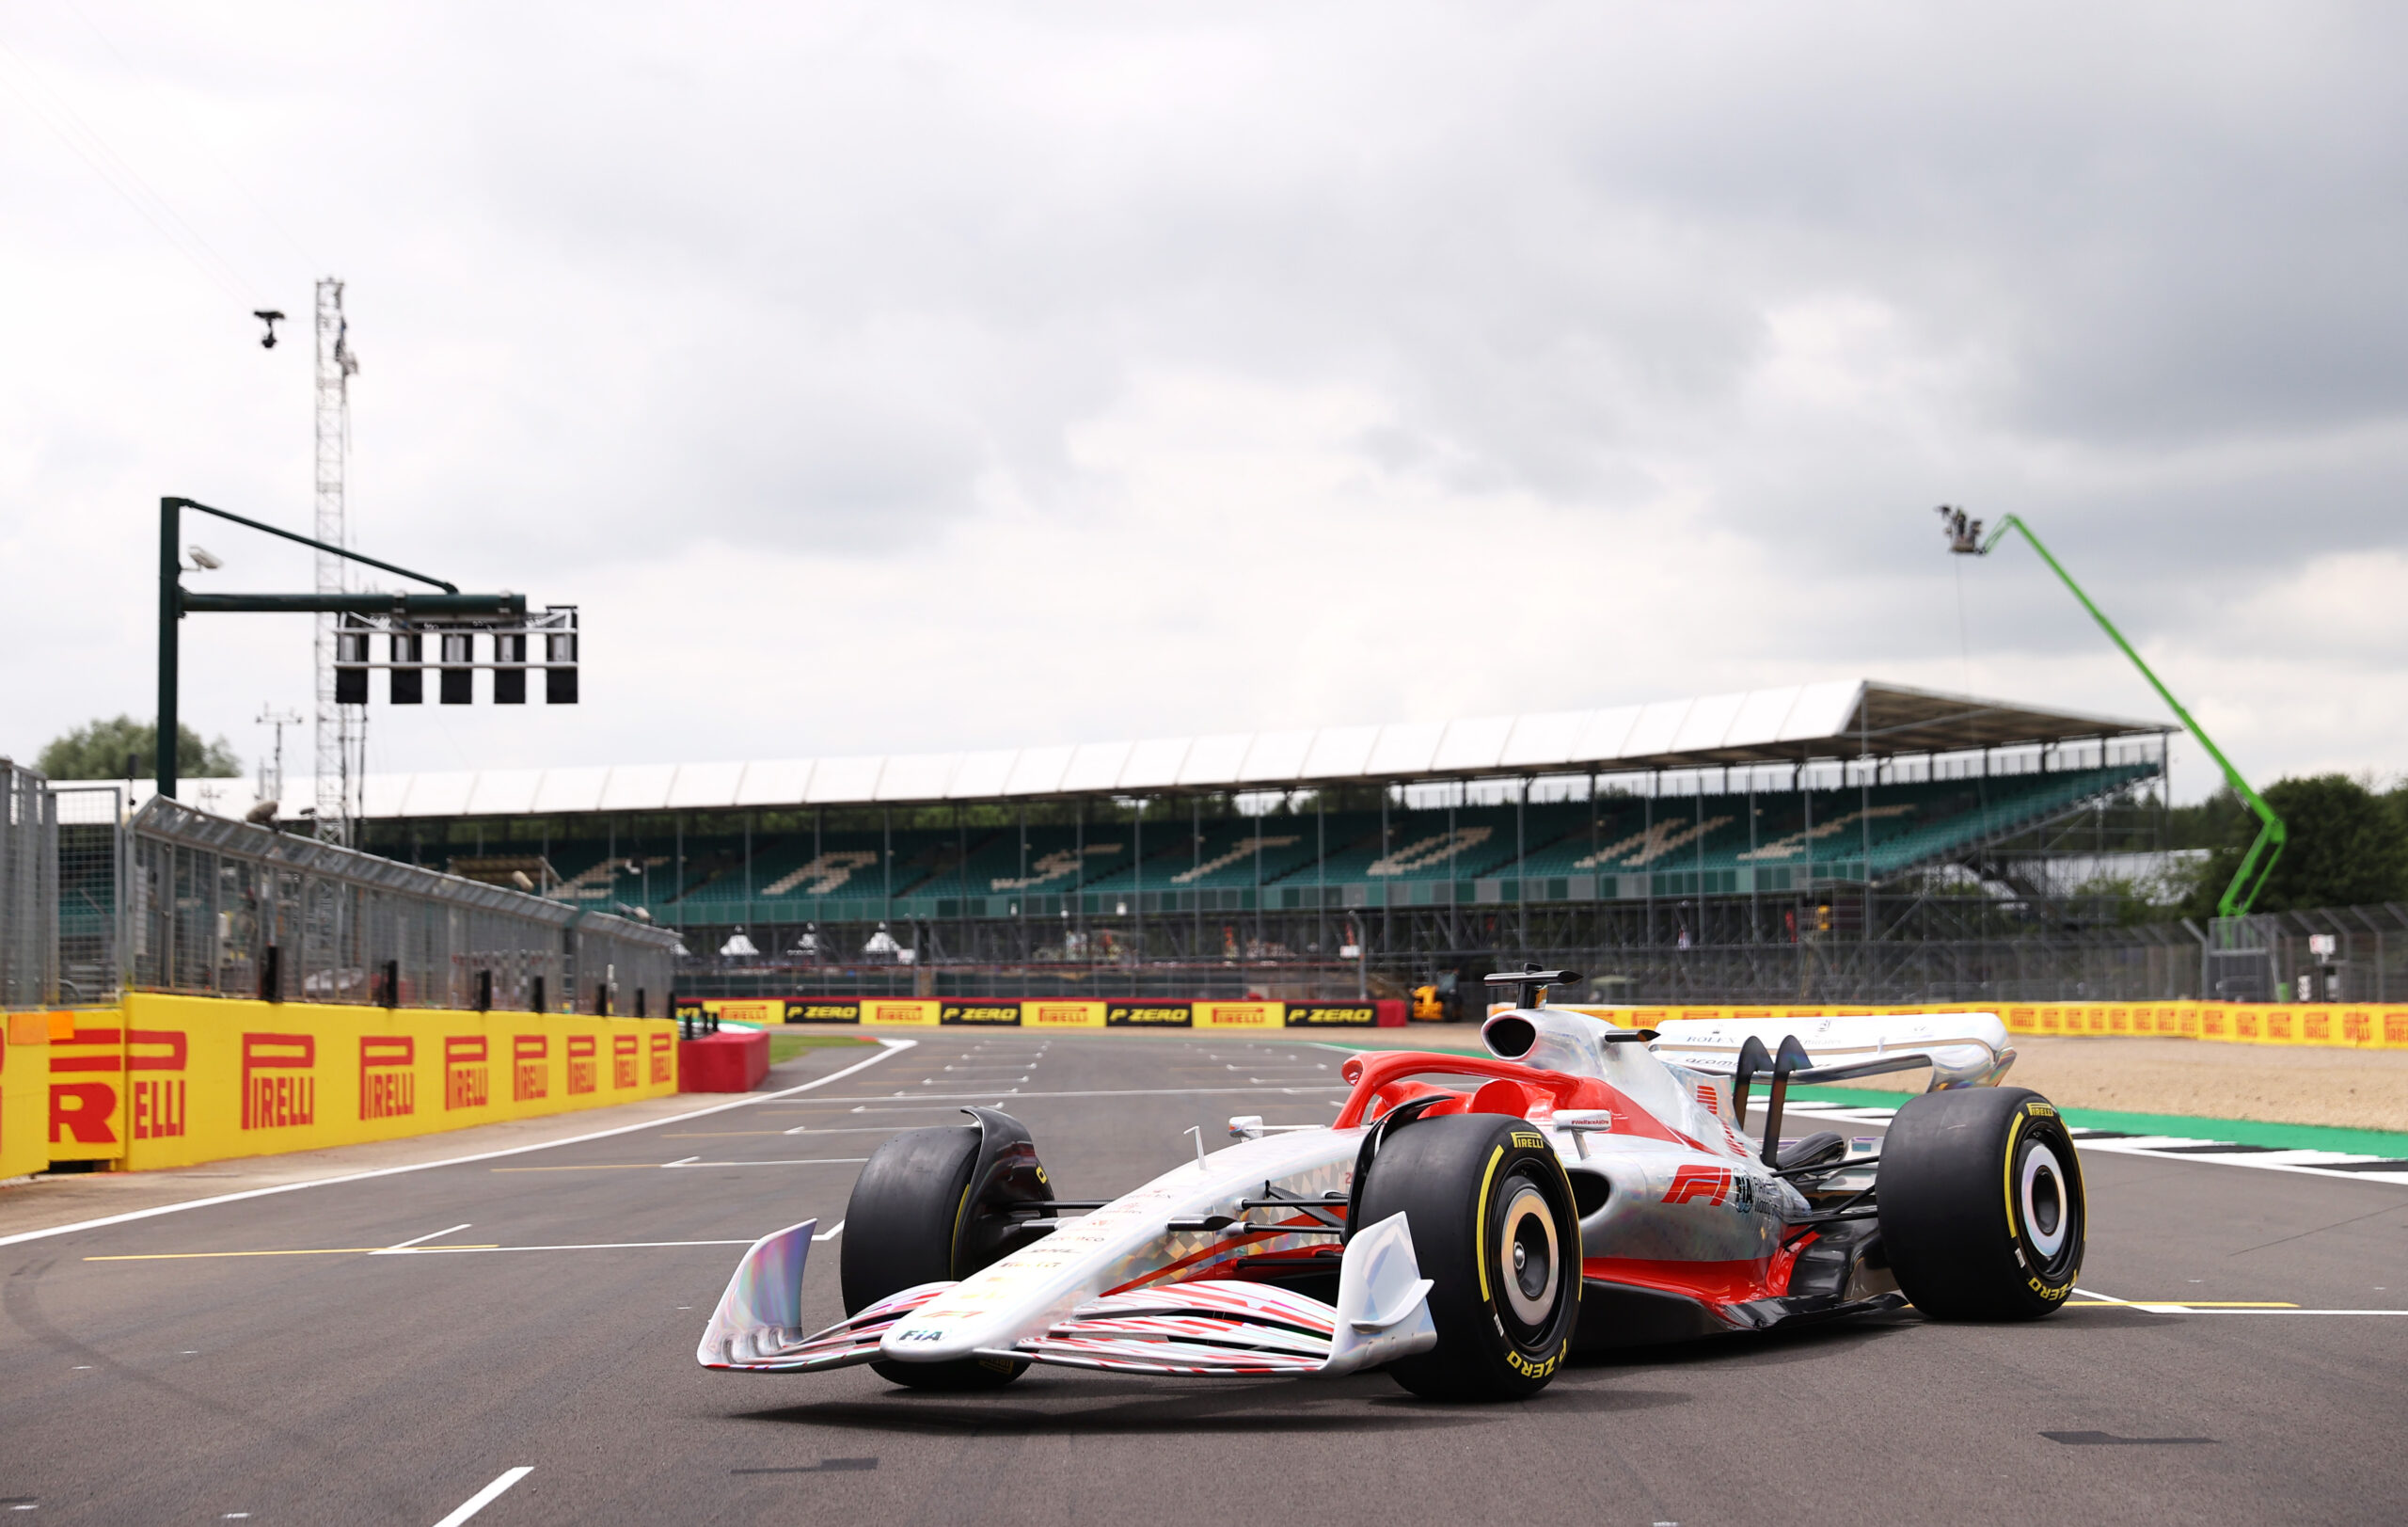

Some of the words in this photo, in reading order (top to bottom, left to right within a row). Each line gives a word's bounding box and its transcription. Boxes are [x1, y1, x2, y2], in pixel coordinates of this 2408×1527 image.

[787, 1007, 801, 1018] P
[803, 1006, 858, 1019] ZERO
[943, 1008, 958, 1020] P
[960, 1008, 1018, 1021] ZERO
[1109, 1009, 1127, 1021] P
[1129, 1008, 1189, 1022] ZERO
[1288, 1009, 1306, 1022] P
[1307, 1009, 1373, 1022] ZERO
[242, 1032, 315, 1131] PIRELLI
[359, 1036, 415, 1121] PIRELLI
[445, 1035, 488, 1111] PIRELLI
[2026, 1103, 2054, 1117] PIRELLI
[1511, 1132, 1545, 1149] PIRELLI
[2028, 1277, 2069, 1301] ZERO
[1507, 1350, 1556, 1379] ZERO
